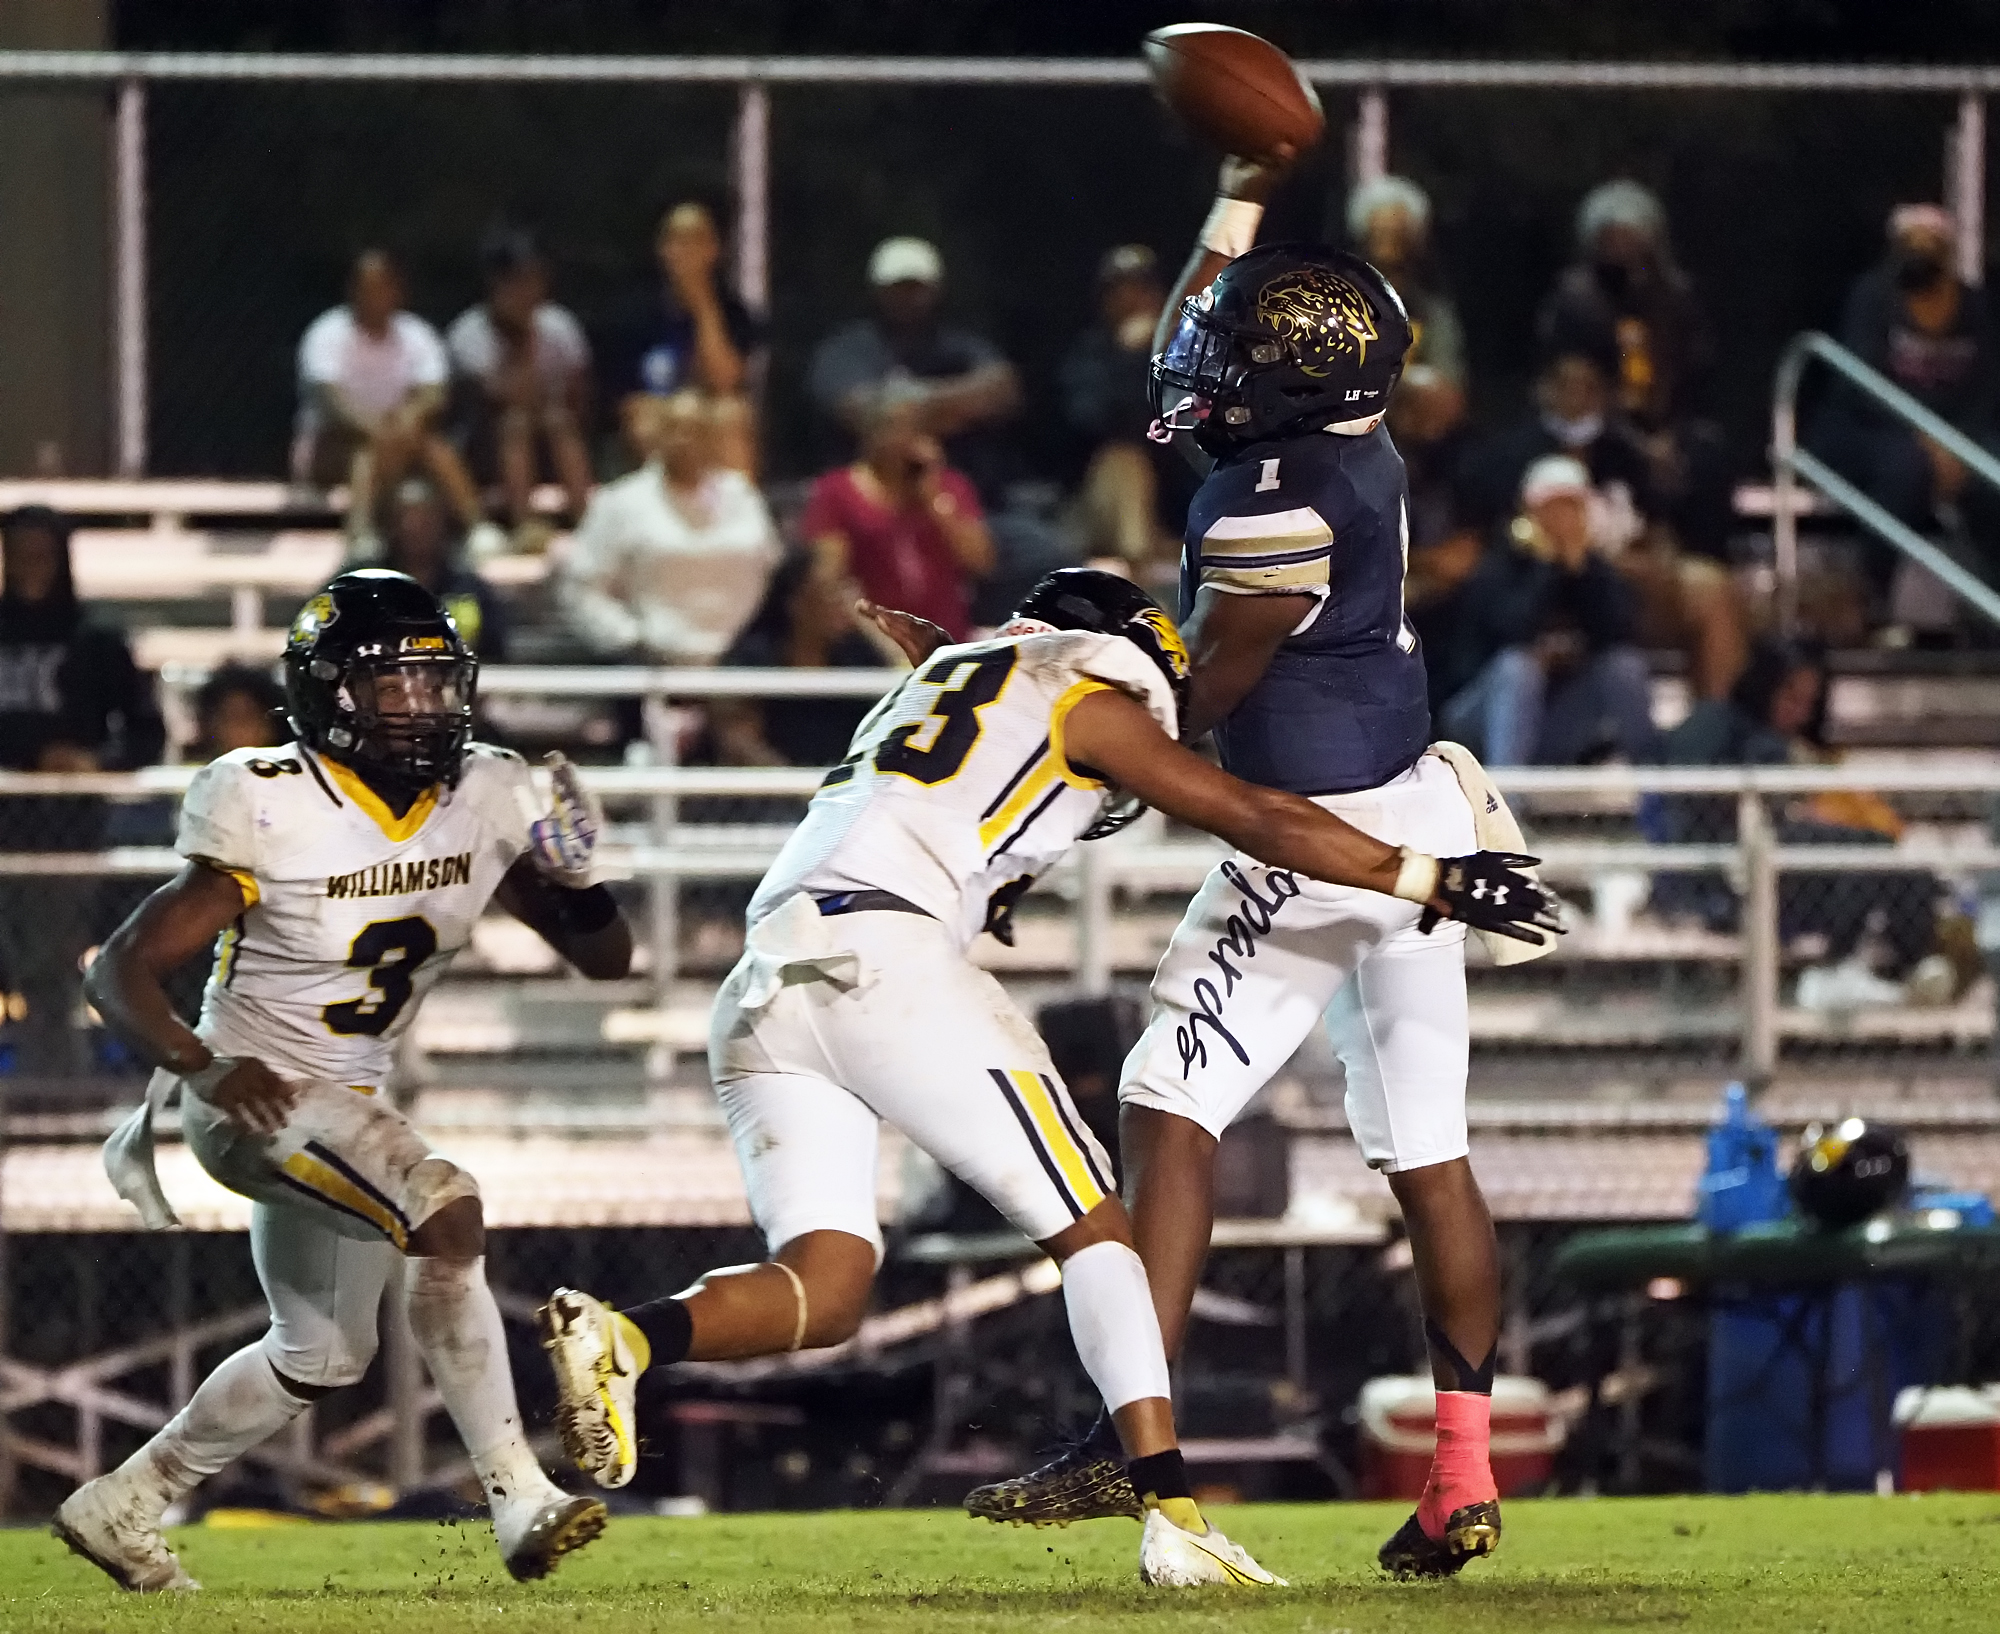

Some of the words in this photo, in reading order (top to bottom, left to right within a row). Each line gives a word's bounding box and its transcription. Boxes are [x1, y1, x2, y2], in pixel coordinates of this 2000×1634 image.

[1344, 389, 1361, 401] LH
[1255, 458, 1281, 493] 1
[327, 851, 471, 899] WILLIAMSON
[322, 914, 438, 1038] 3
[1176, 860, 1301, 1081] opards
